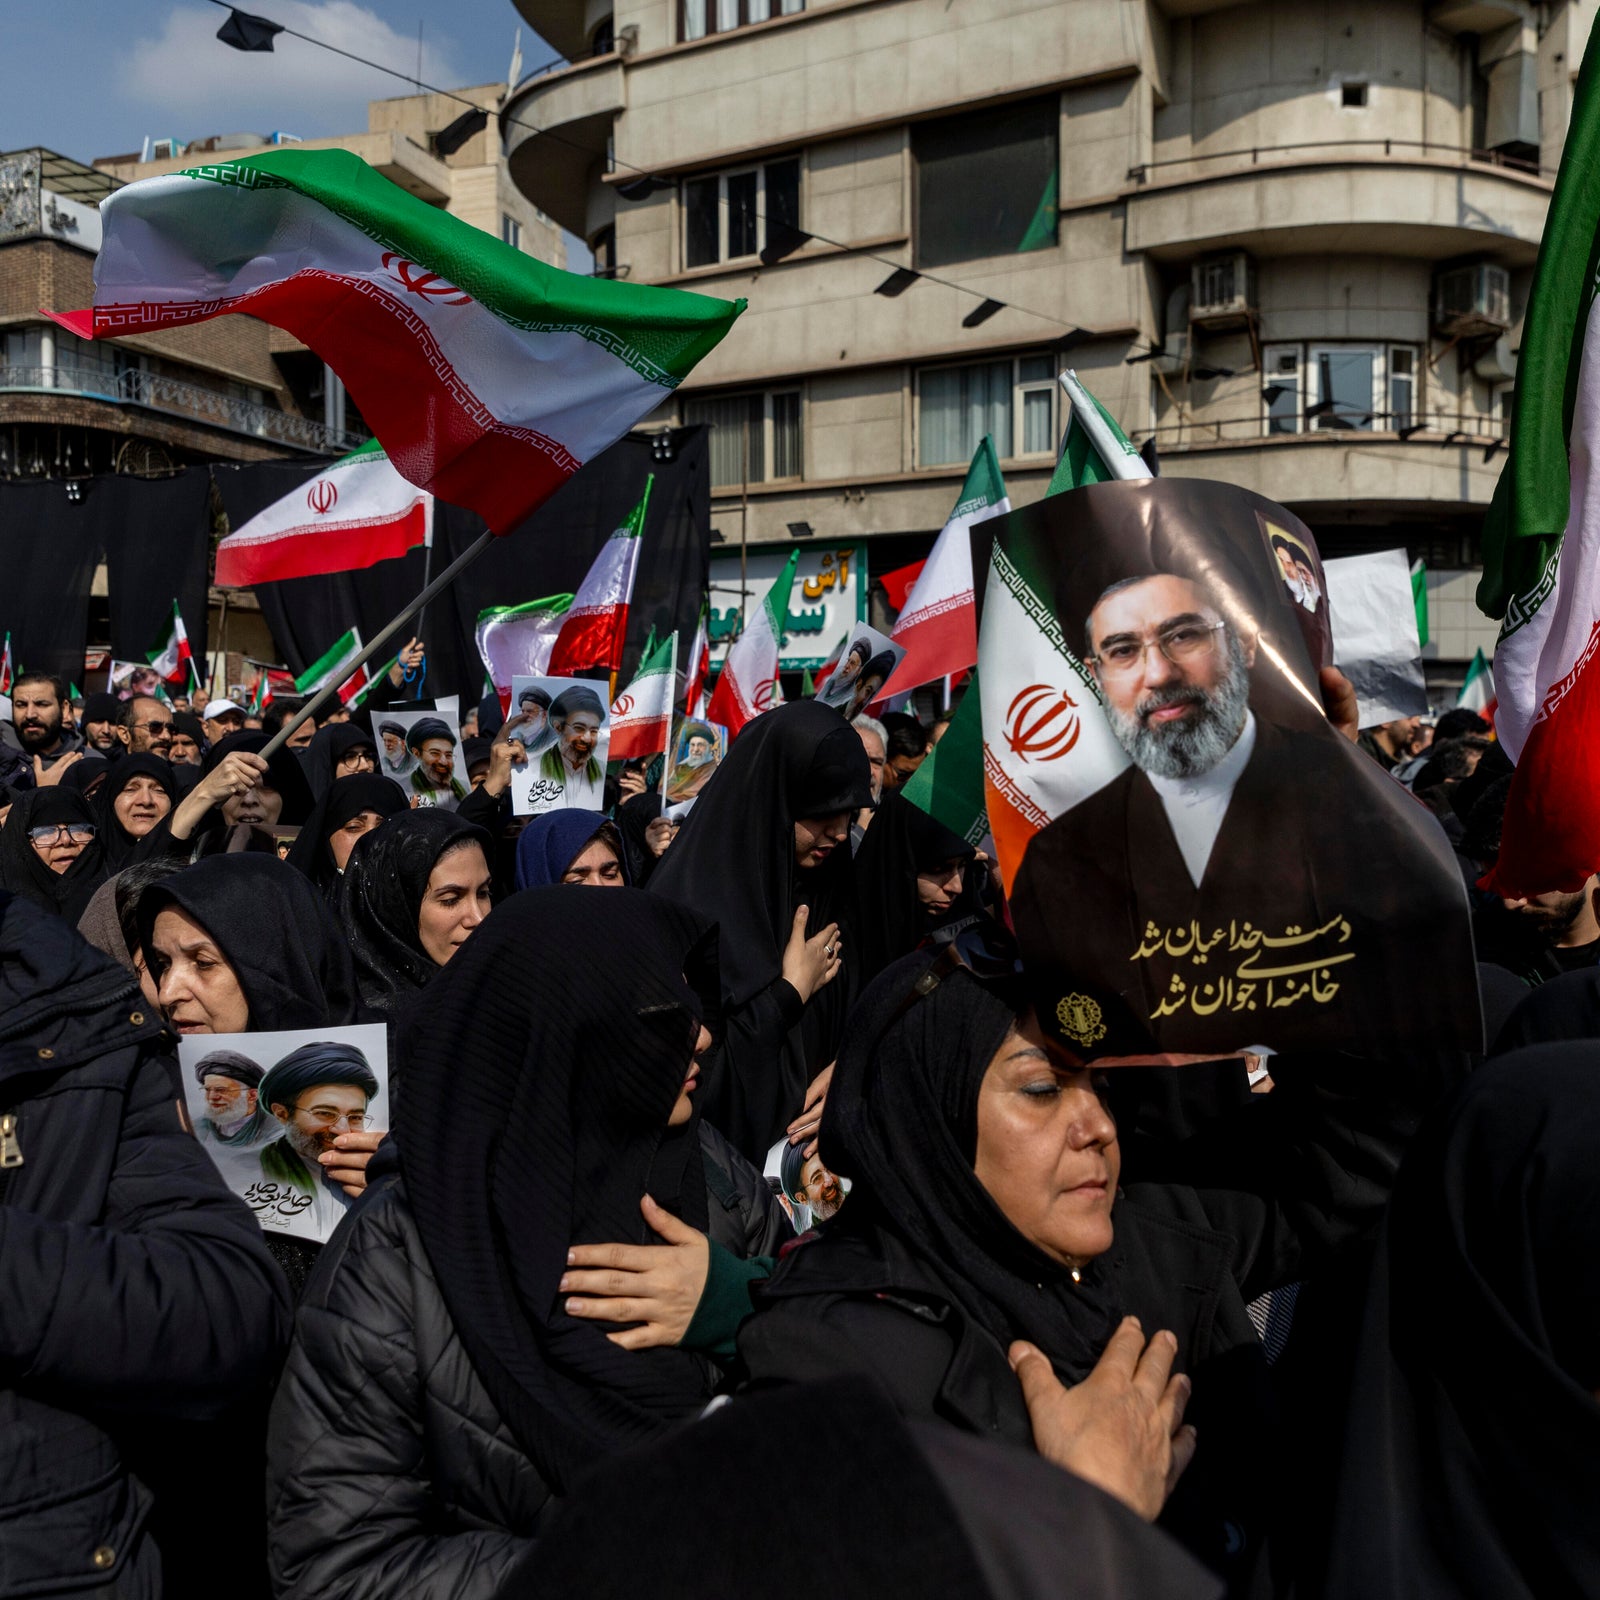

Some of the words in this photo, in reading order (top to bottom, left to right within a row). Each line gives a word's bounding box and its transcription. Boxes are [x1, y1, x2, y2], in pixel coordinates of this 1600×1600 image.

[803, 549, 853, 598] آش
[1129, 920, 1164, 961] شد
[1165, 919, 1227, 965] عیان
[1229, 919, 1263, 951] خدا
[1262, 914, 1352, 948] دست
[1150, 973, 1187, 1019] شد
[1191, 975, 1256, 1016] جوان
[277, 1186, 313, 1216] صالح
